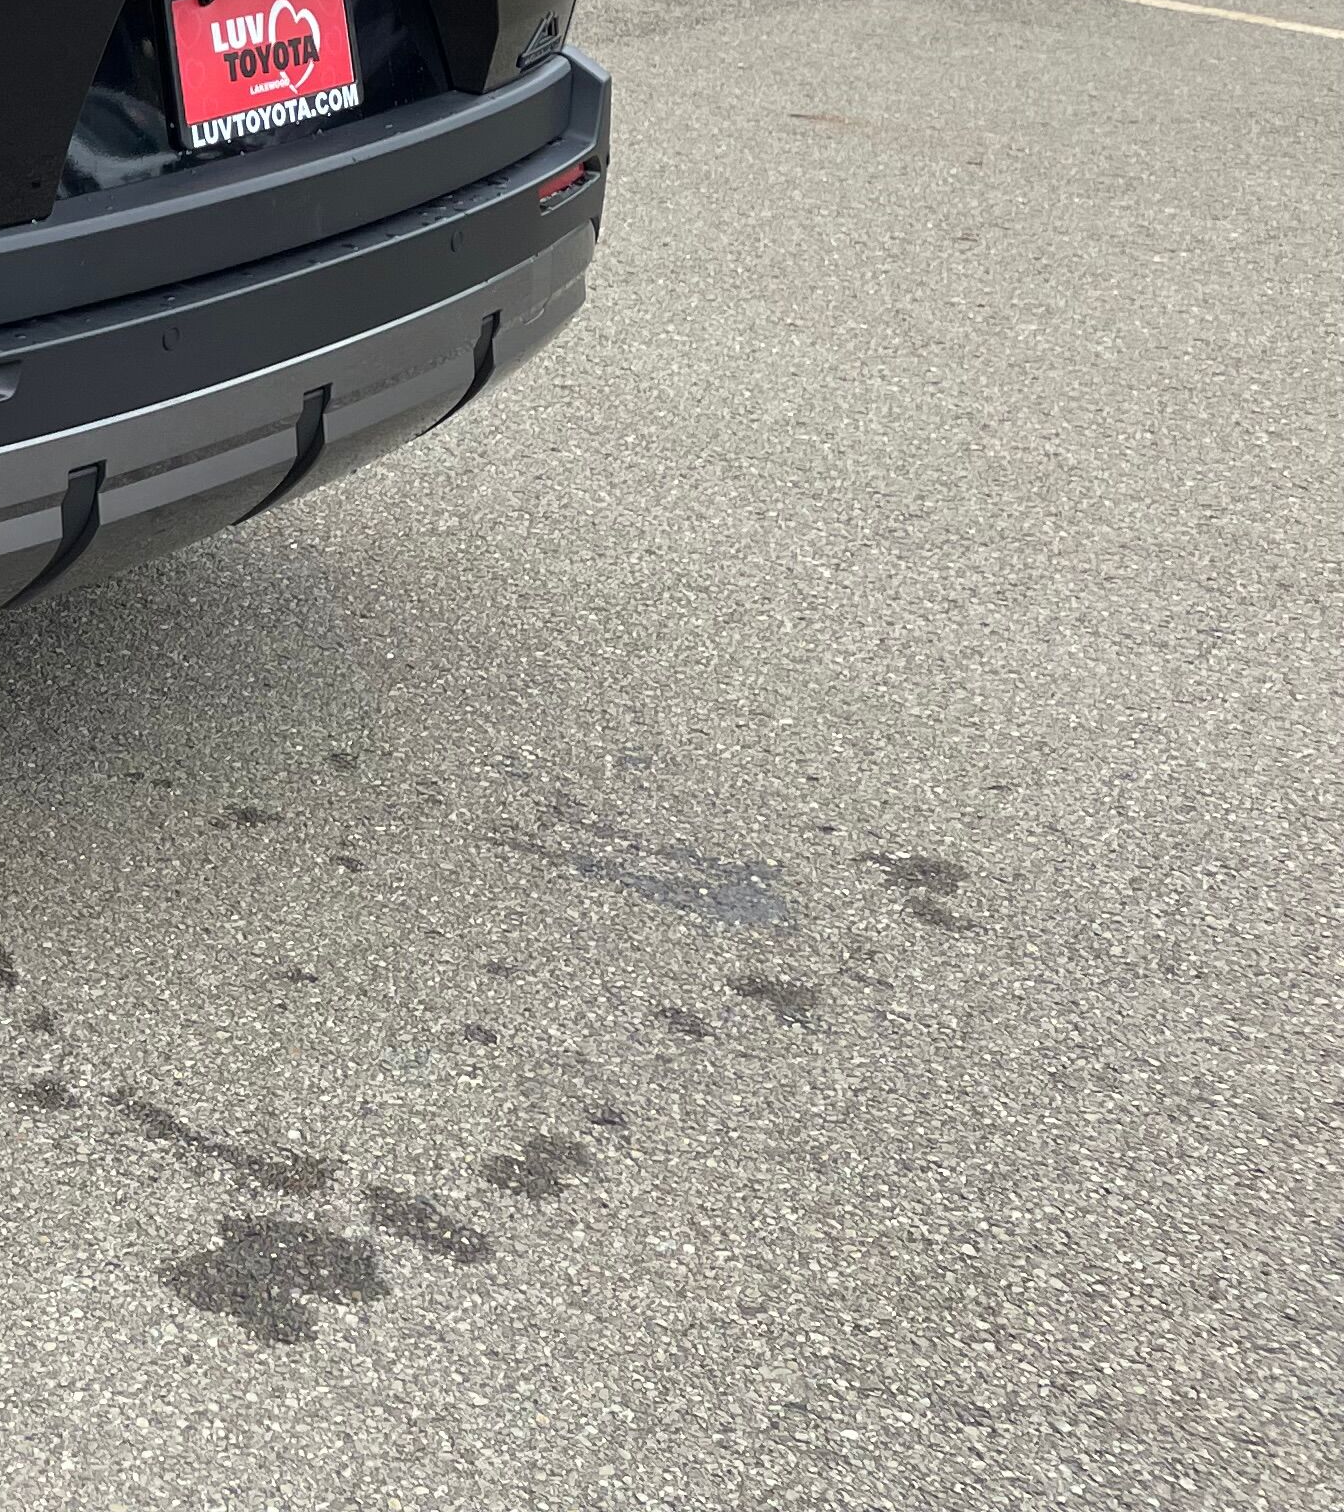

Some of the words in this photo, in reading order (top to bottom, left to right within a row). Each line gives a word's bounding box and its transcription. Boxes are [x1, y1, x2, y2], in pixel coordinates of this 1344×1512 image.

[210, 12, 266, 53] LUV
[223, 35, 321, 82] TOYOTA
[249, 78, 291, 96] LAKEWOOD
[191, 83, 360, 149] LUVTOYOTA.COM
